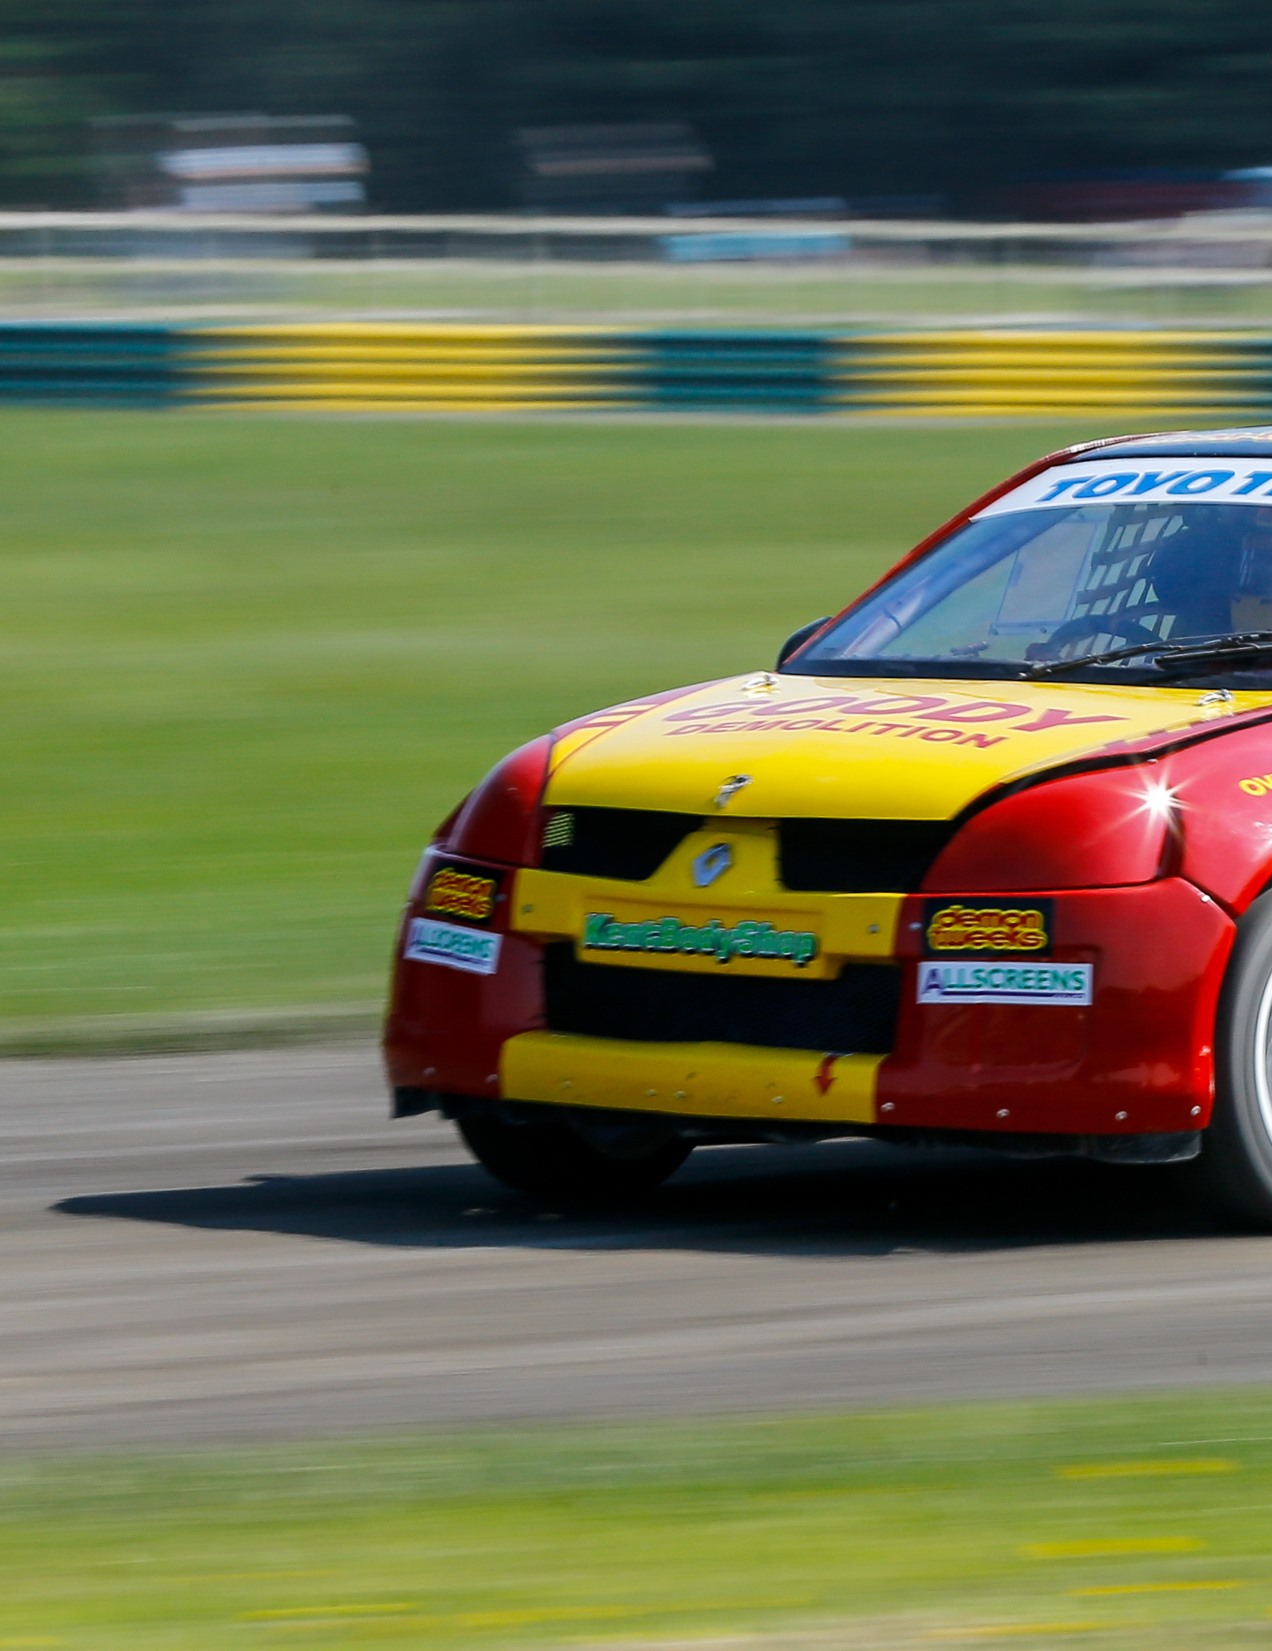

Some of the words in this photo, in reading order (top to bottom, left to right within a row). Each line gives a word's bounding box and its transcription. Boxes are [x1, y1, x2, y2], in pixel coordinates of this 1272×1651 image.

[1036, 470, 1235, 501] TOYO
[662, 694, 1131, 732] GOODY
[663, 717, 1010, 750] DEMOLITION
[931, 905, 1045, 930] demon
[584, 912, 817, 968] KentBodyShop
[921, 967, 1087, 995] ALLSCREENS
